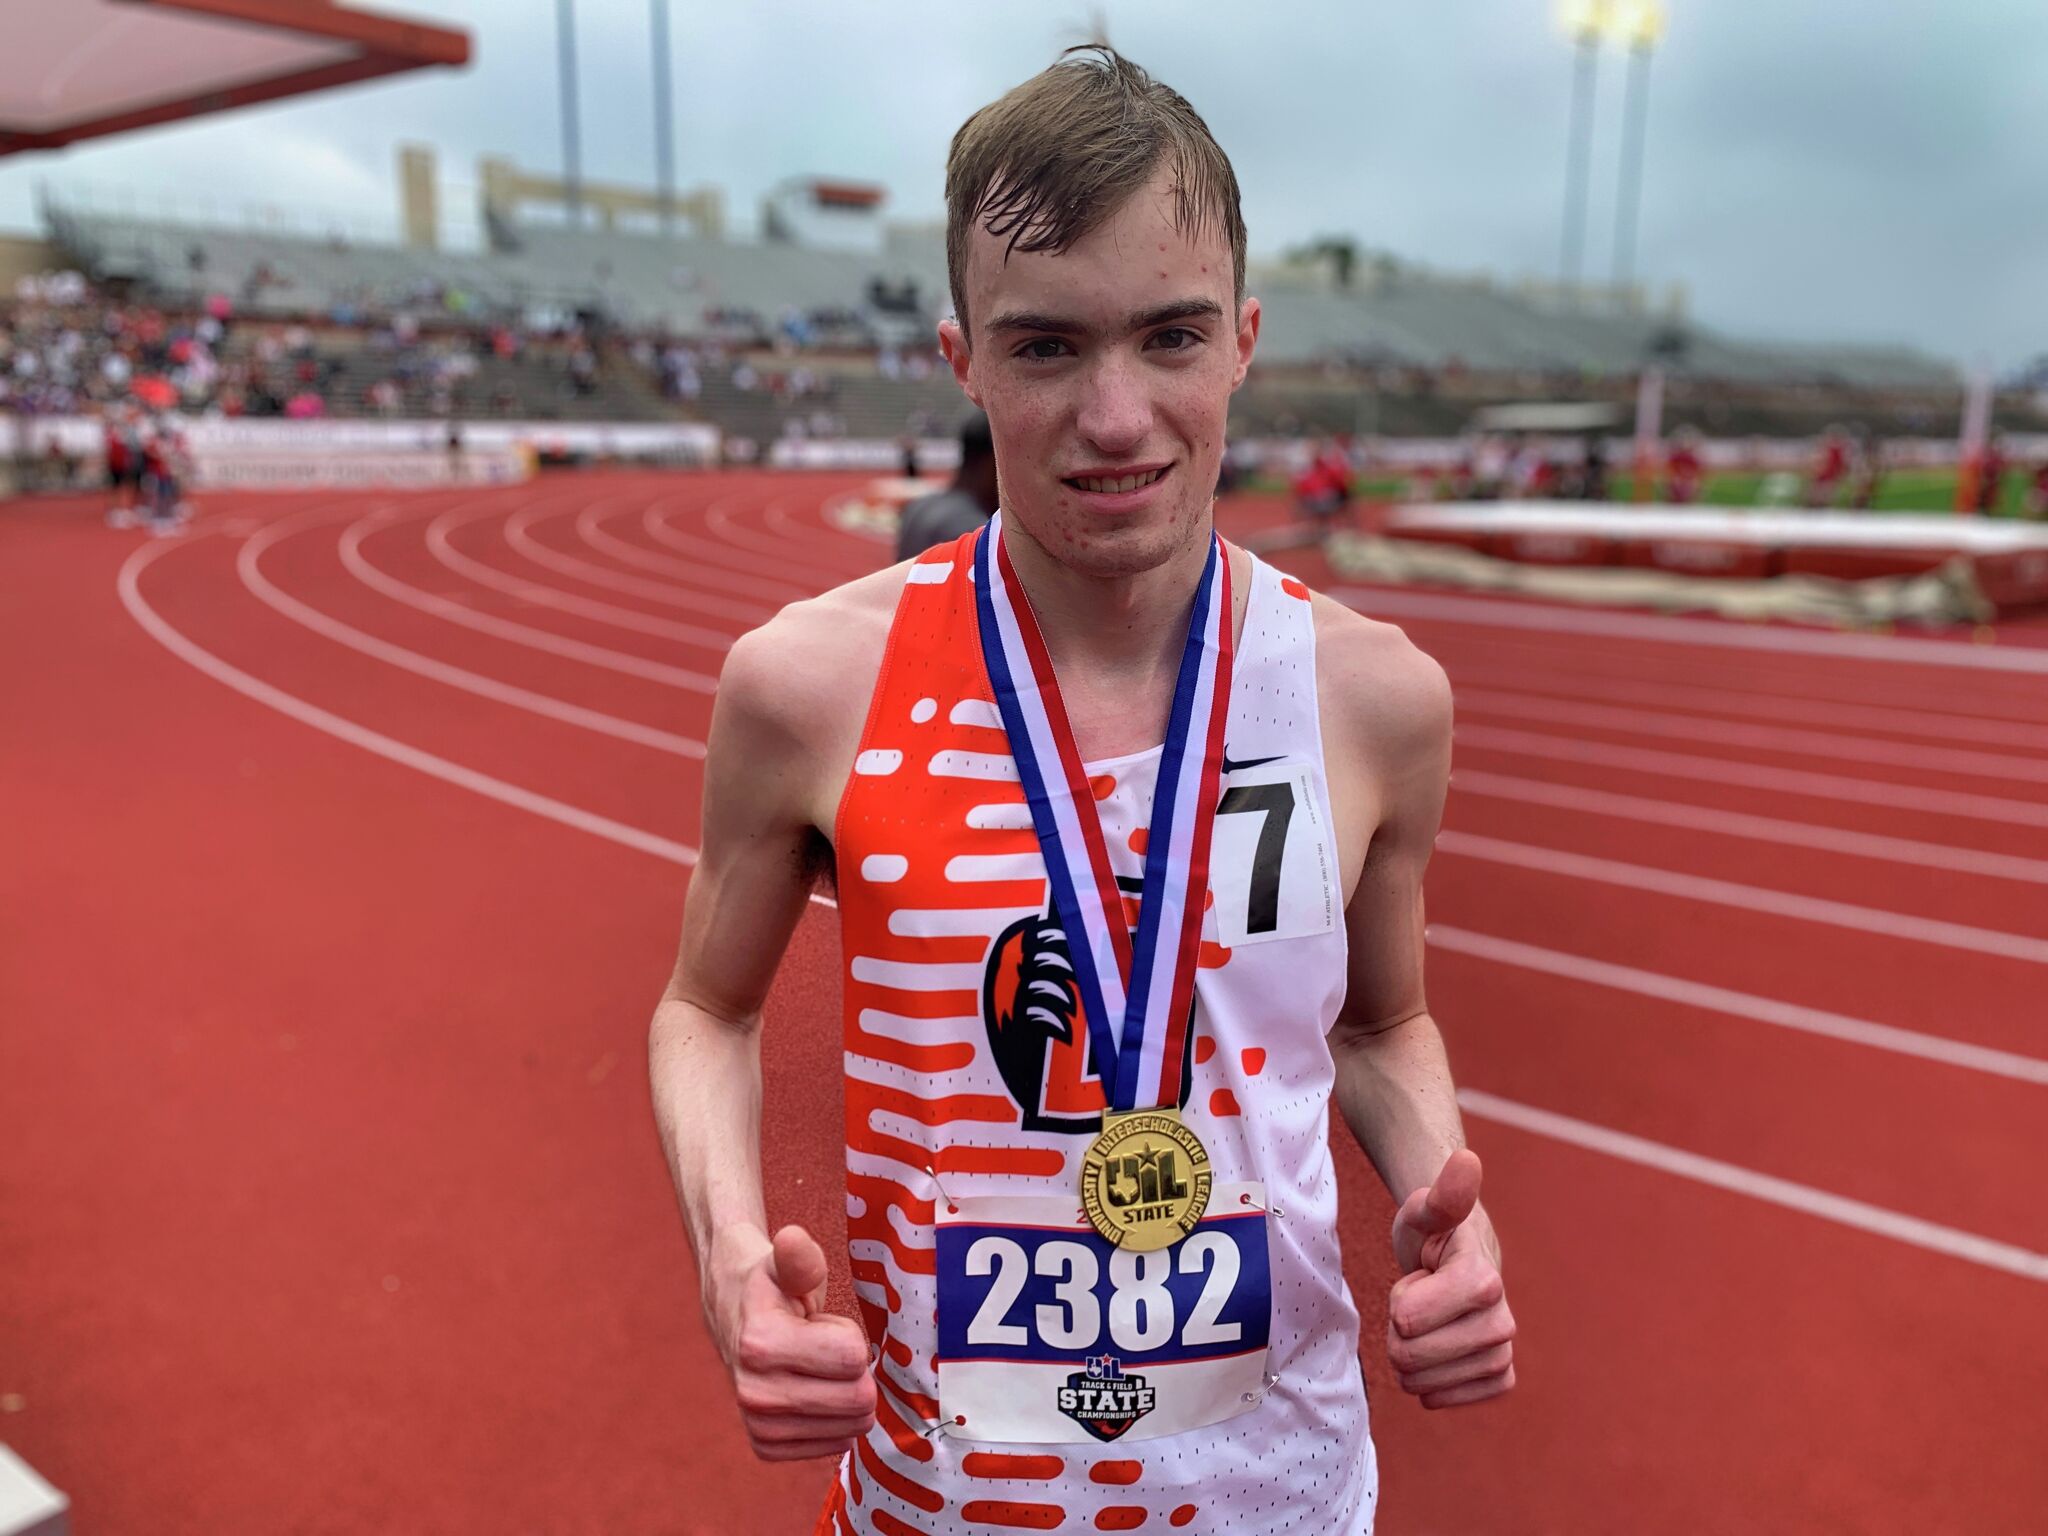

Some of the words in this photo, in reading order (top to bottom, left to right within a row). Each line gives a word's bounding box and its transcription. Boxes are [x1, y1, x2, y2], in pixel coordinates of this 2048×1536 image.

[1216, 782, 1296, 935] 7
[1095, 1117, 1207, 1164] INTERSCHOLASTIC
[1105, 1141, 1188, 1207] UIL
[1084, 1163, 1123, 1244] UNIVERSITY
[1123, 1203, 1175, 1224] STATE
[1181, 1170, 1211, 1231] LEAGUE
[965, 1231, 1241, 1351] 2382
[1081, 1381, 1105, 1390] TRACK
[1113, 1382, 1133, 1391] FIELD
[1086, 1353, 1126, 1381] UIL
[1060, 1388, 1153, 1411] STATE
[1077, 1411, 1137, 1419] CHAMPIONSHIPS
